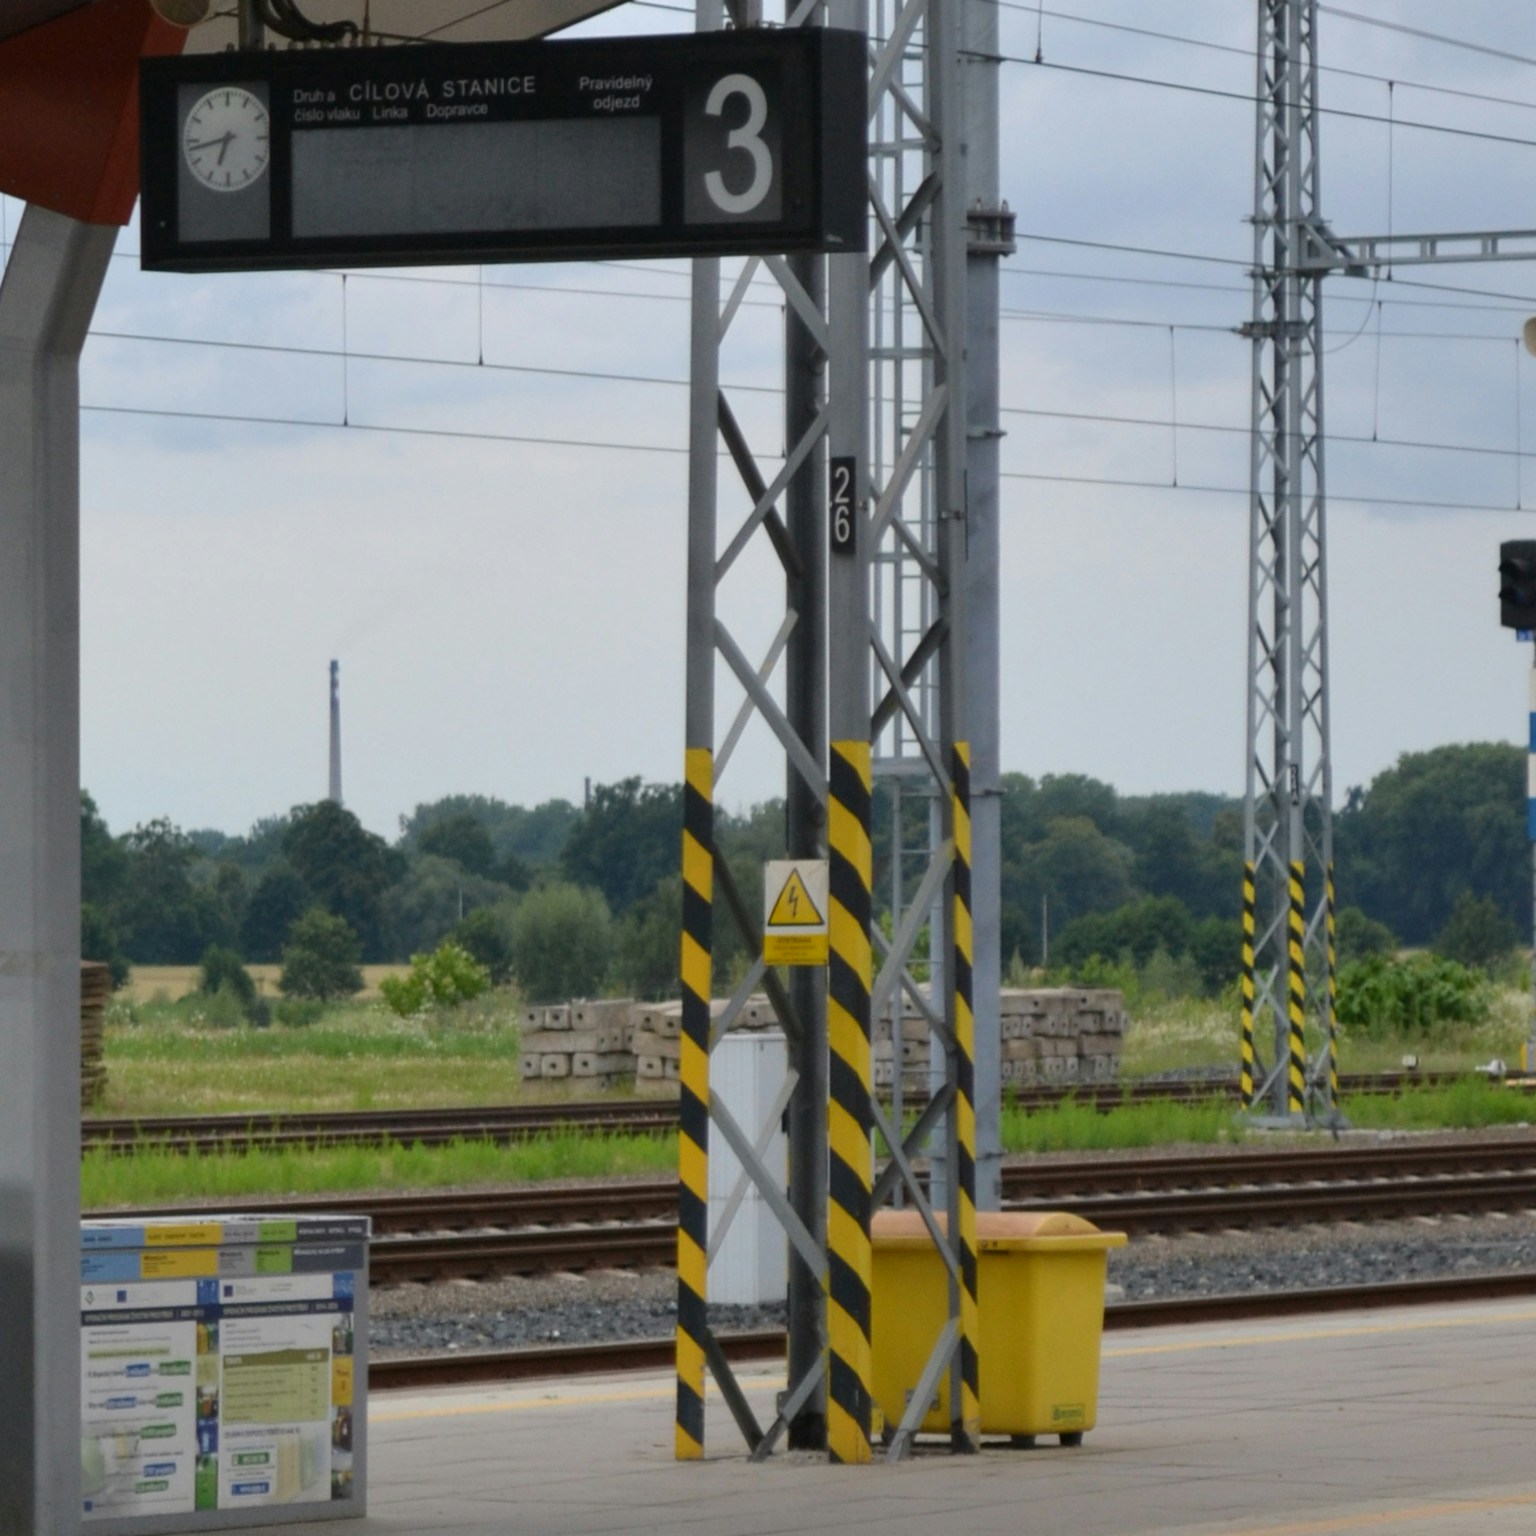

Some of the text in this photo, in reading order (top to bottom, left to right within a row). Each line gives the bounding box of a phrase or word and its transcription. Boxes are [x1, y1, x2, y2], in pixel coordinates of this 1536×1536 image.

[294, 75, 536, 104] Druh a CÍLOVÁ STANICE
[579, 75, 654, 92] Pravidelný
[294, 102, 489, 123] číslo vlaku Linka Dopravce
[593, 94, 641, 112] odjezd
[703, 72, 774, 214] 3
